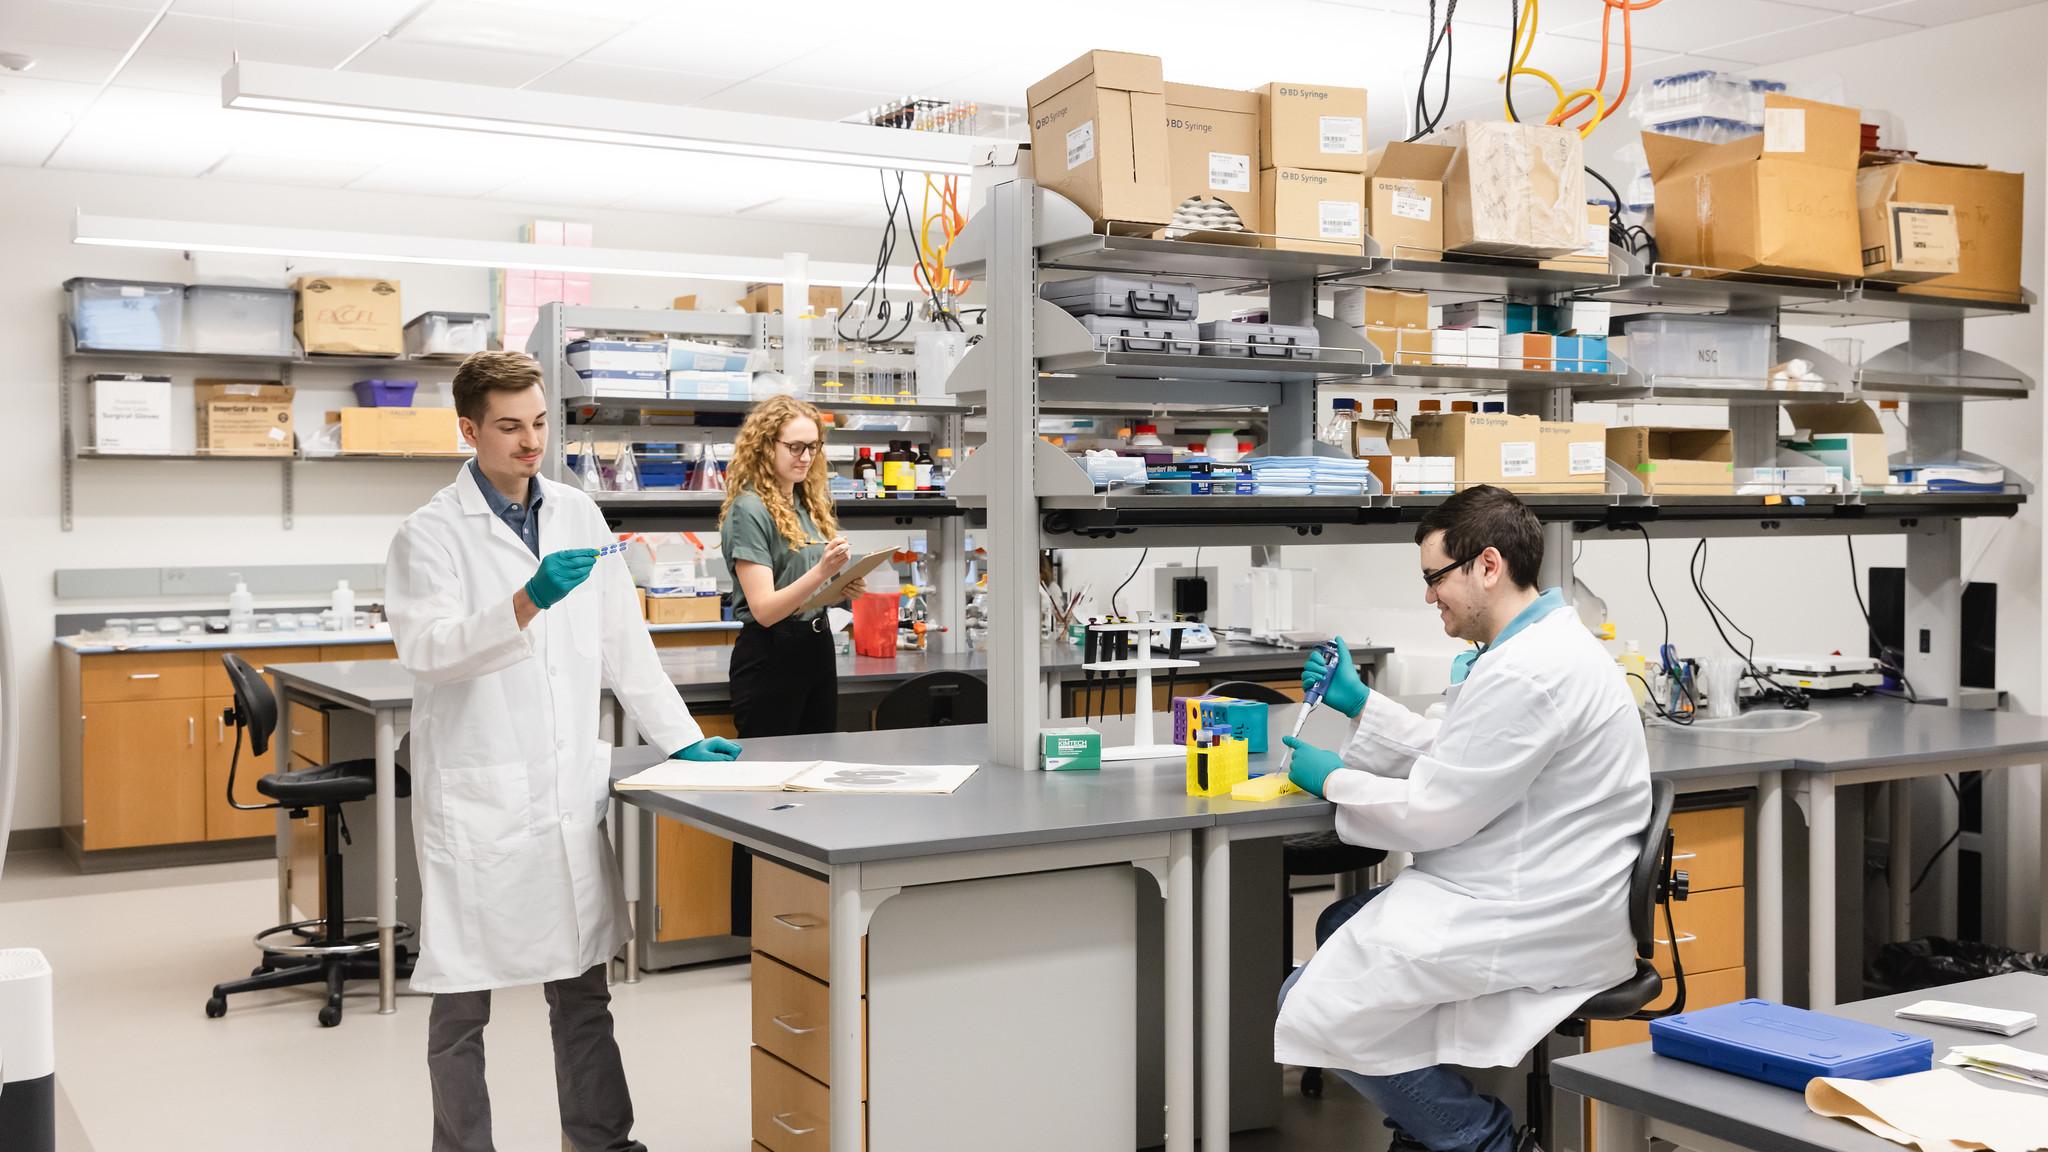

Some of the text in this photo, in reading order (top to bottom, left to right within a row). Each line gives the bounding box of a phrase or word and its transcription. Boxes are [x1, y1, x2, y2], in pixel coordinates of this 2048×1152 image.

[1300, 89, 1328, 100] Syringe
[1050, 107, 1068, 122] Syringe
[1170, 119, 1213, 133] BD Syringe
[1301, 174, 1328, 184] Syringe
[1698, 349, 1718, 363] NSC
[1486, 418, 1508, 427] Syringe
